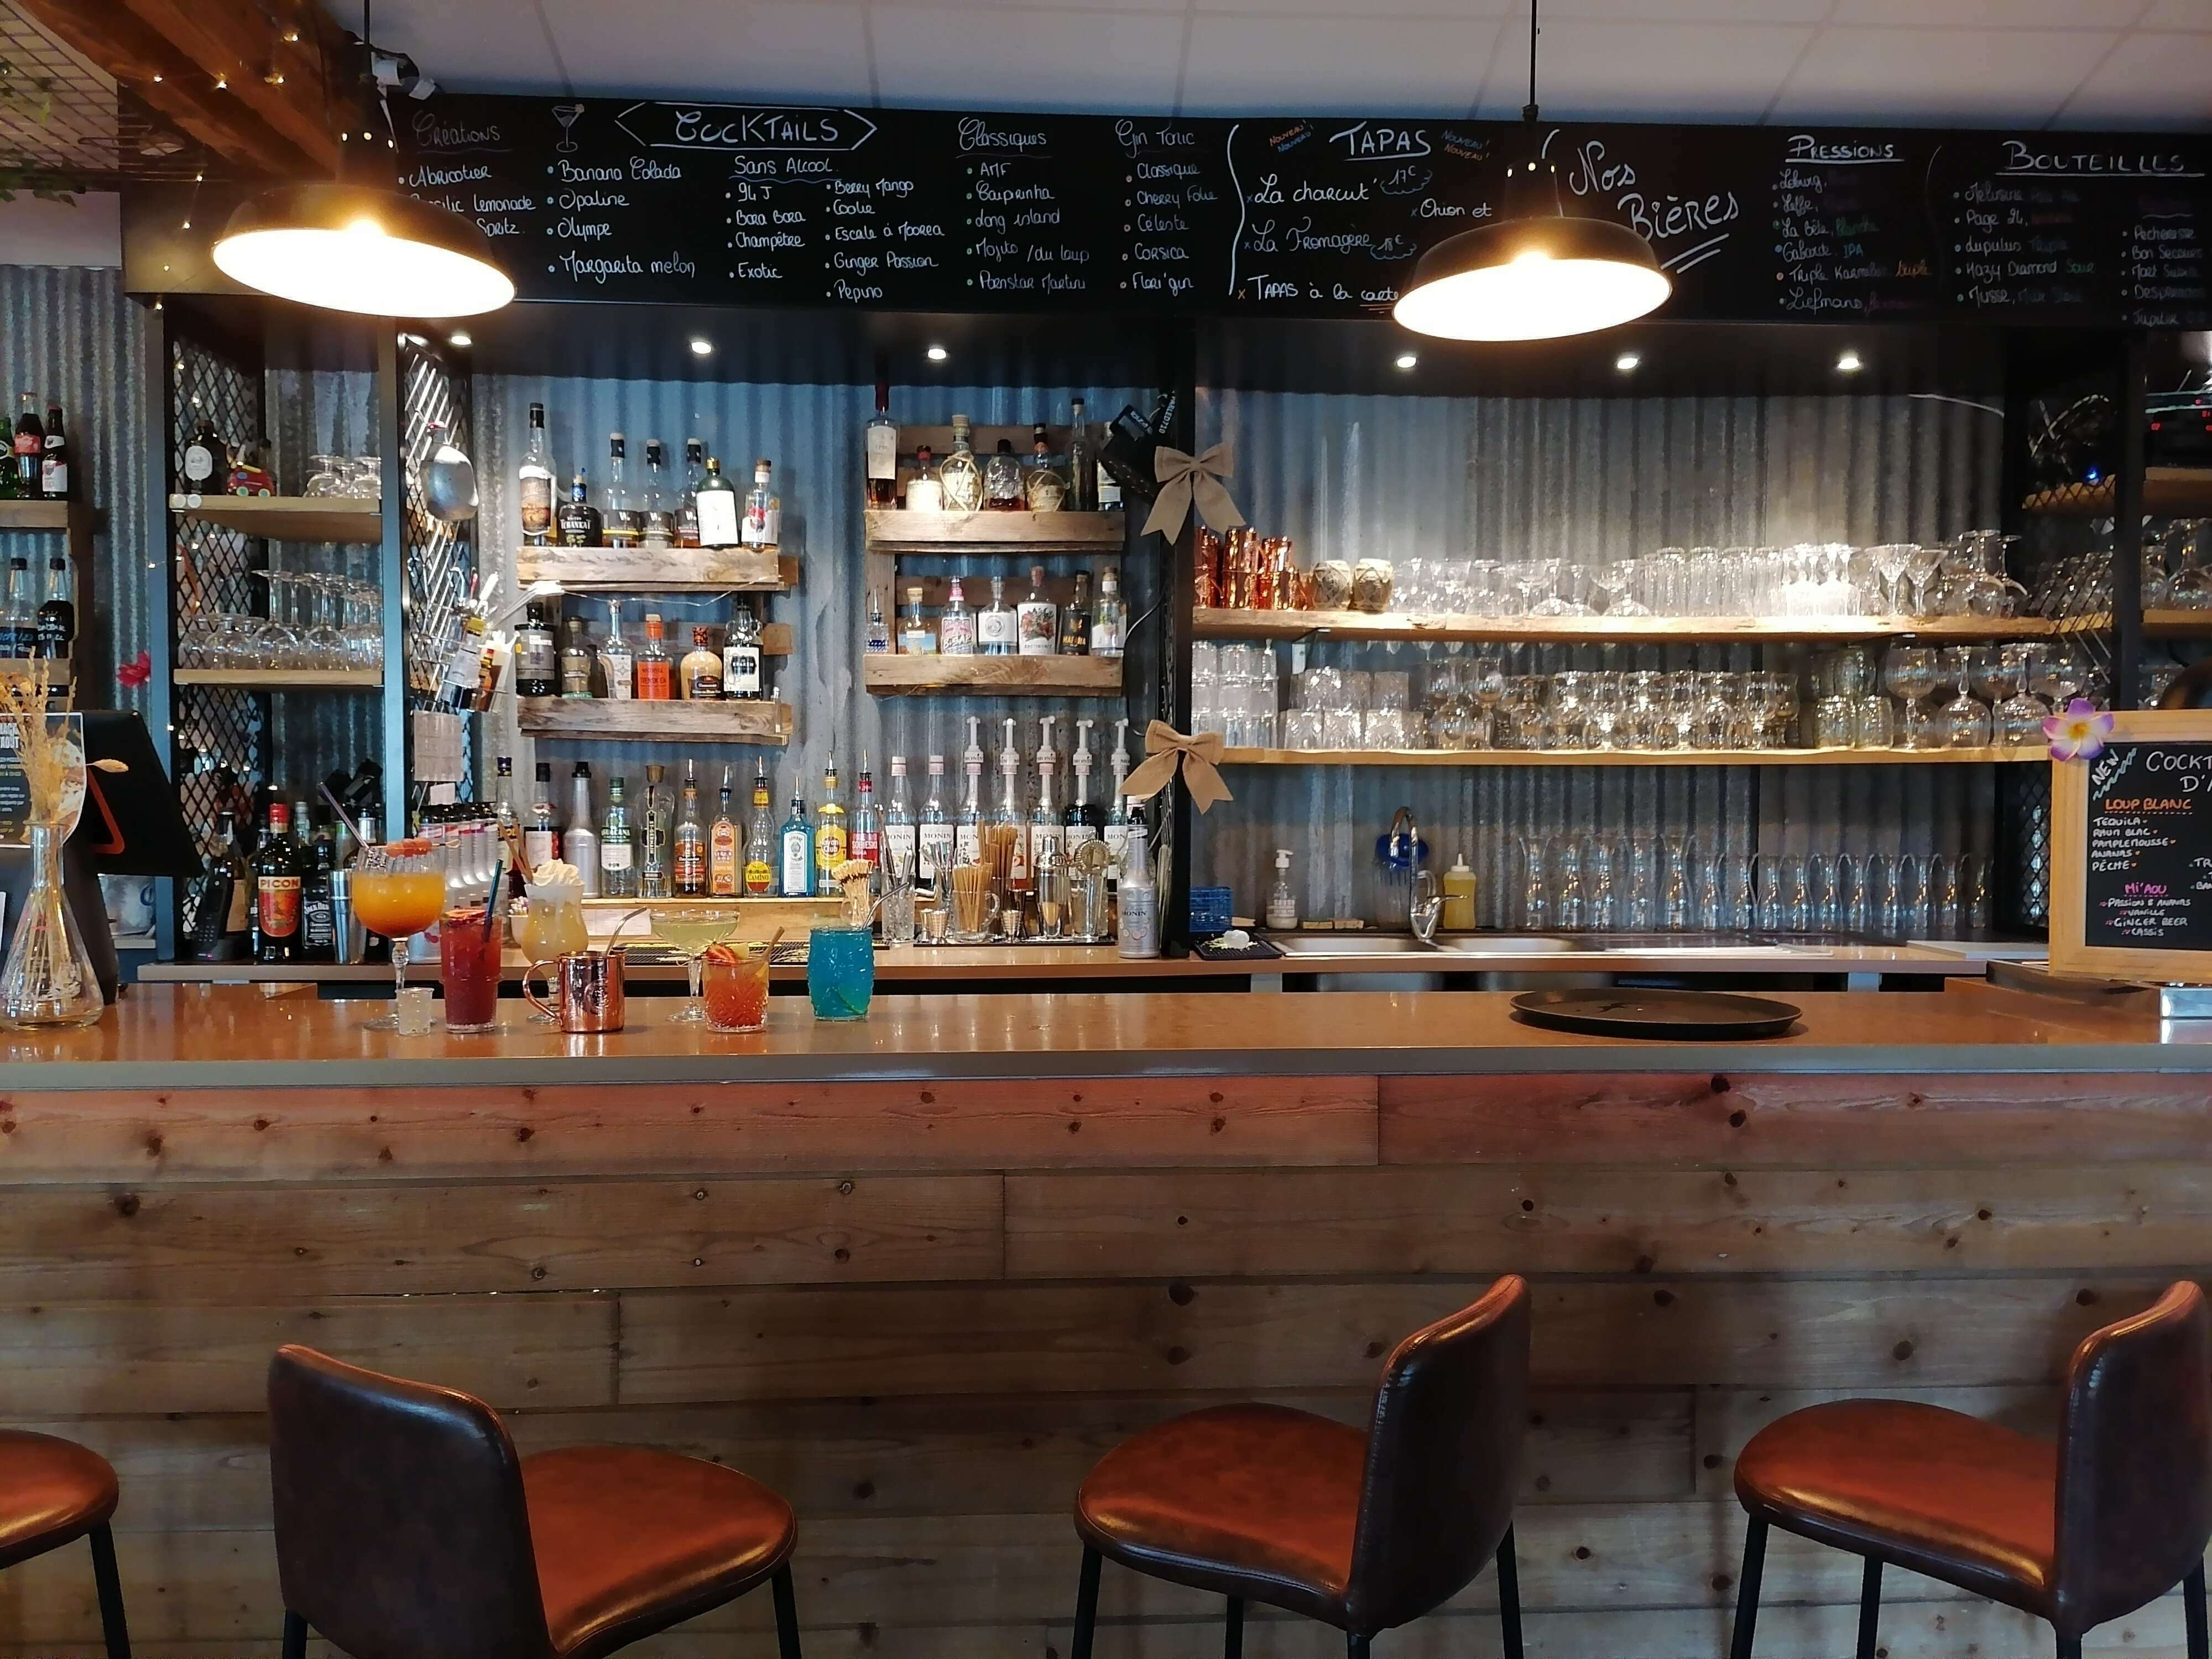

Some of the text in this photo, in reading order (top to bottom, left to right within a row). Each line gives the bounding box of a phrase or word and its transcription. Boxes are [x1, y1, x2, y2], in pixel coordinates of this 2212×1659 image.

[958, 117, 1047, 152] Classiques
[1115, 119, 1195, 158] Gin Tonic
[1329, 121, 1432, 156] TAPAS
[559, 156, 682, 182] Banana Colada
[734, 155, 776, 175] Sans
[1569, 140, 1636, 196] Nos
[2002, 140, 2184, 172] BOUTEILLES
[875, 178, 914, 197] Mango
[1255, 174, 1284, 204] La
[559, 189, 630, 213] Opaline
[1473, 203, 1493, 217] et
[1618, 192, 1740, 243] Bières
[835, 225, 877, 241] Escale
[1252, 220, 1279, 252] La
[559, 251, 695, 284] Margarita melon
[738, 263, 782, 278] Exotic
[1248, 274, 1298, 300] TAPAS
[1310, 282, 1323, 299] à
[1334, 284, 1353, 299] la
[2092, 748, 2119, 785] NEW
[2105, 797, 2192, 810] LOUP BLANC
[852, 841, 878, 849] SOBIESKI
[260, 879, 299, 888] PICON
[2162, 917, 2188, 926] BEER
